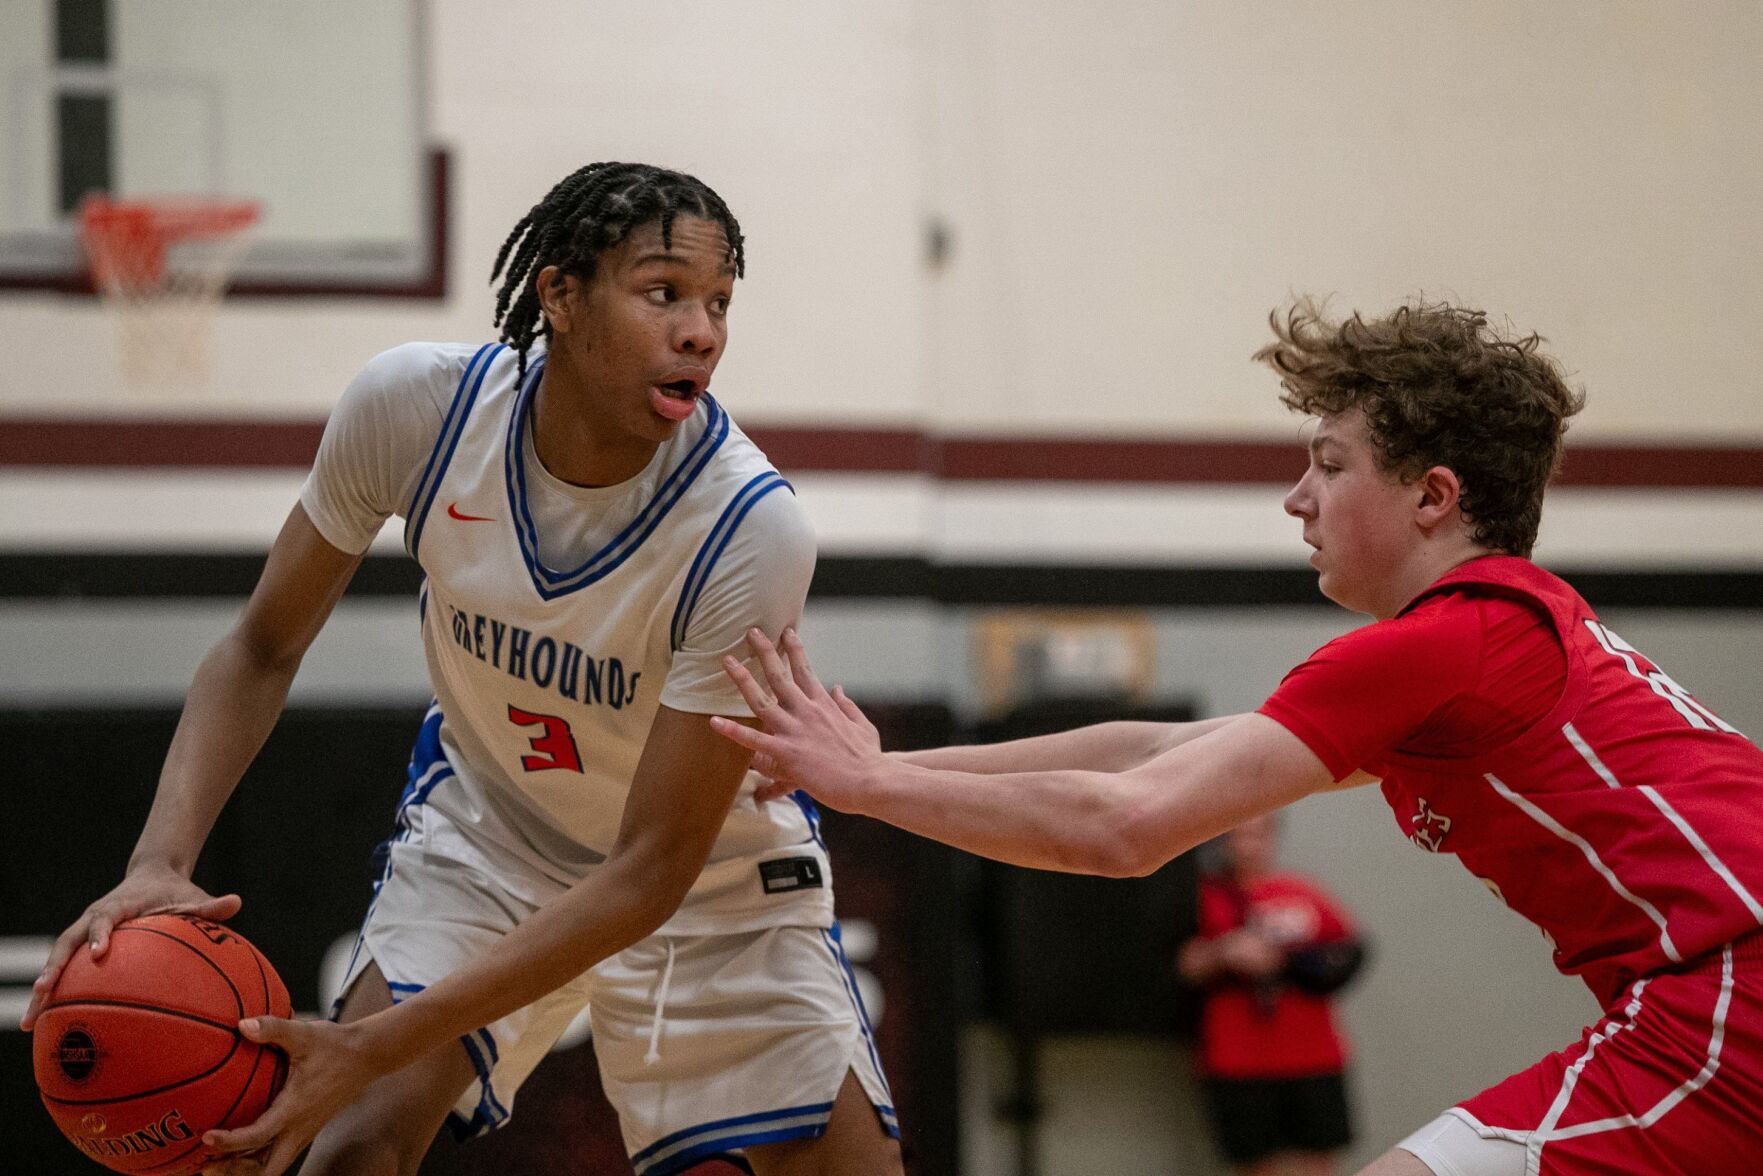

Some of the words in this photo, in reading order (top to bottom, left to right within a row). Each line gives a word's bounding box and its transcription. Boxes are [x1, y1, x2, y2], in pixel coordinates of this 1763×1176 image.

[507, 702, 584, 774] 3
[804, 865, 815, 879] L
[73, 1108, 195, 1157] ALDING
